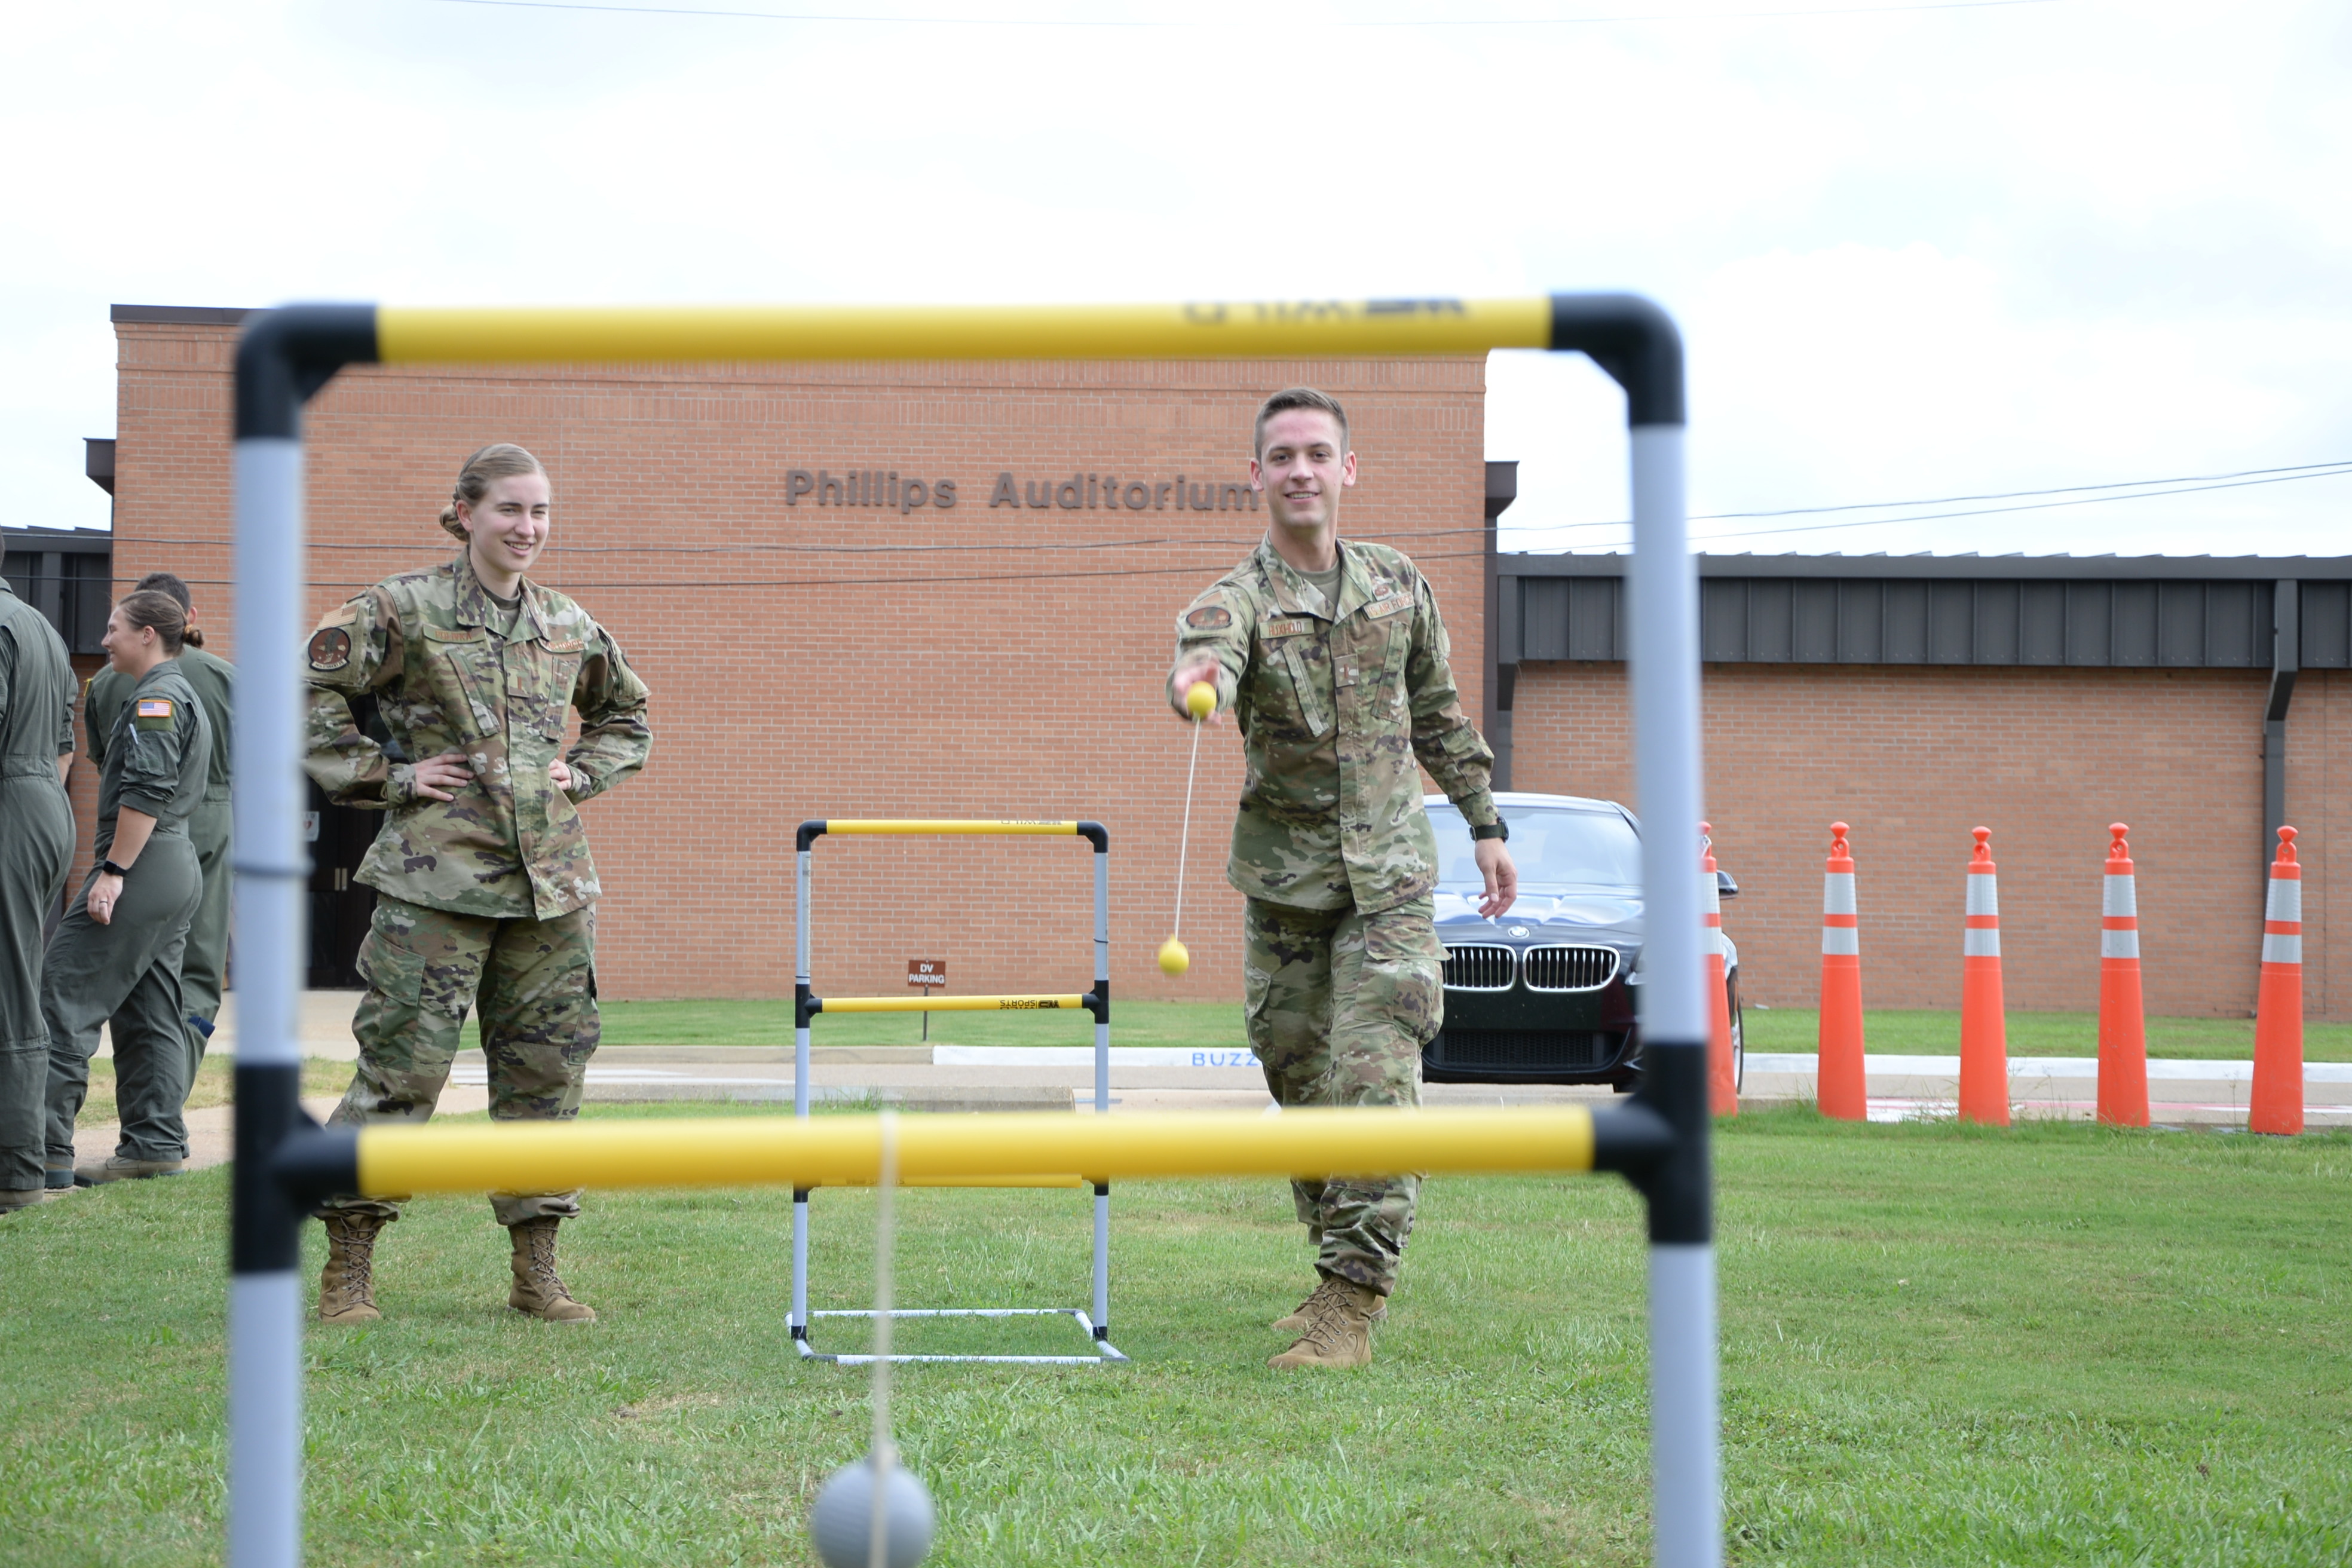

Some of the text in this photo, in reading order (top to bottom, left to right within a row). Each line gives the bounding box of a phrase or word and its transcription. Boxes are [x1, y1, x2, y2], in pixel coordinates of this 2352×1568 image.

[786, 469, 1259, 514] Phillips Auditorium
[920, 963, 934, 973] DV
[908, 973, 944, 984] PARKING
[1192, 1053, 1258, 1066] BUZZ
